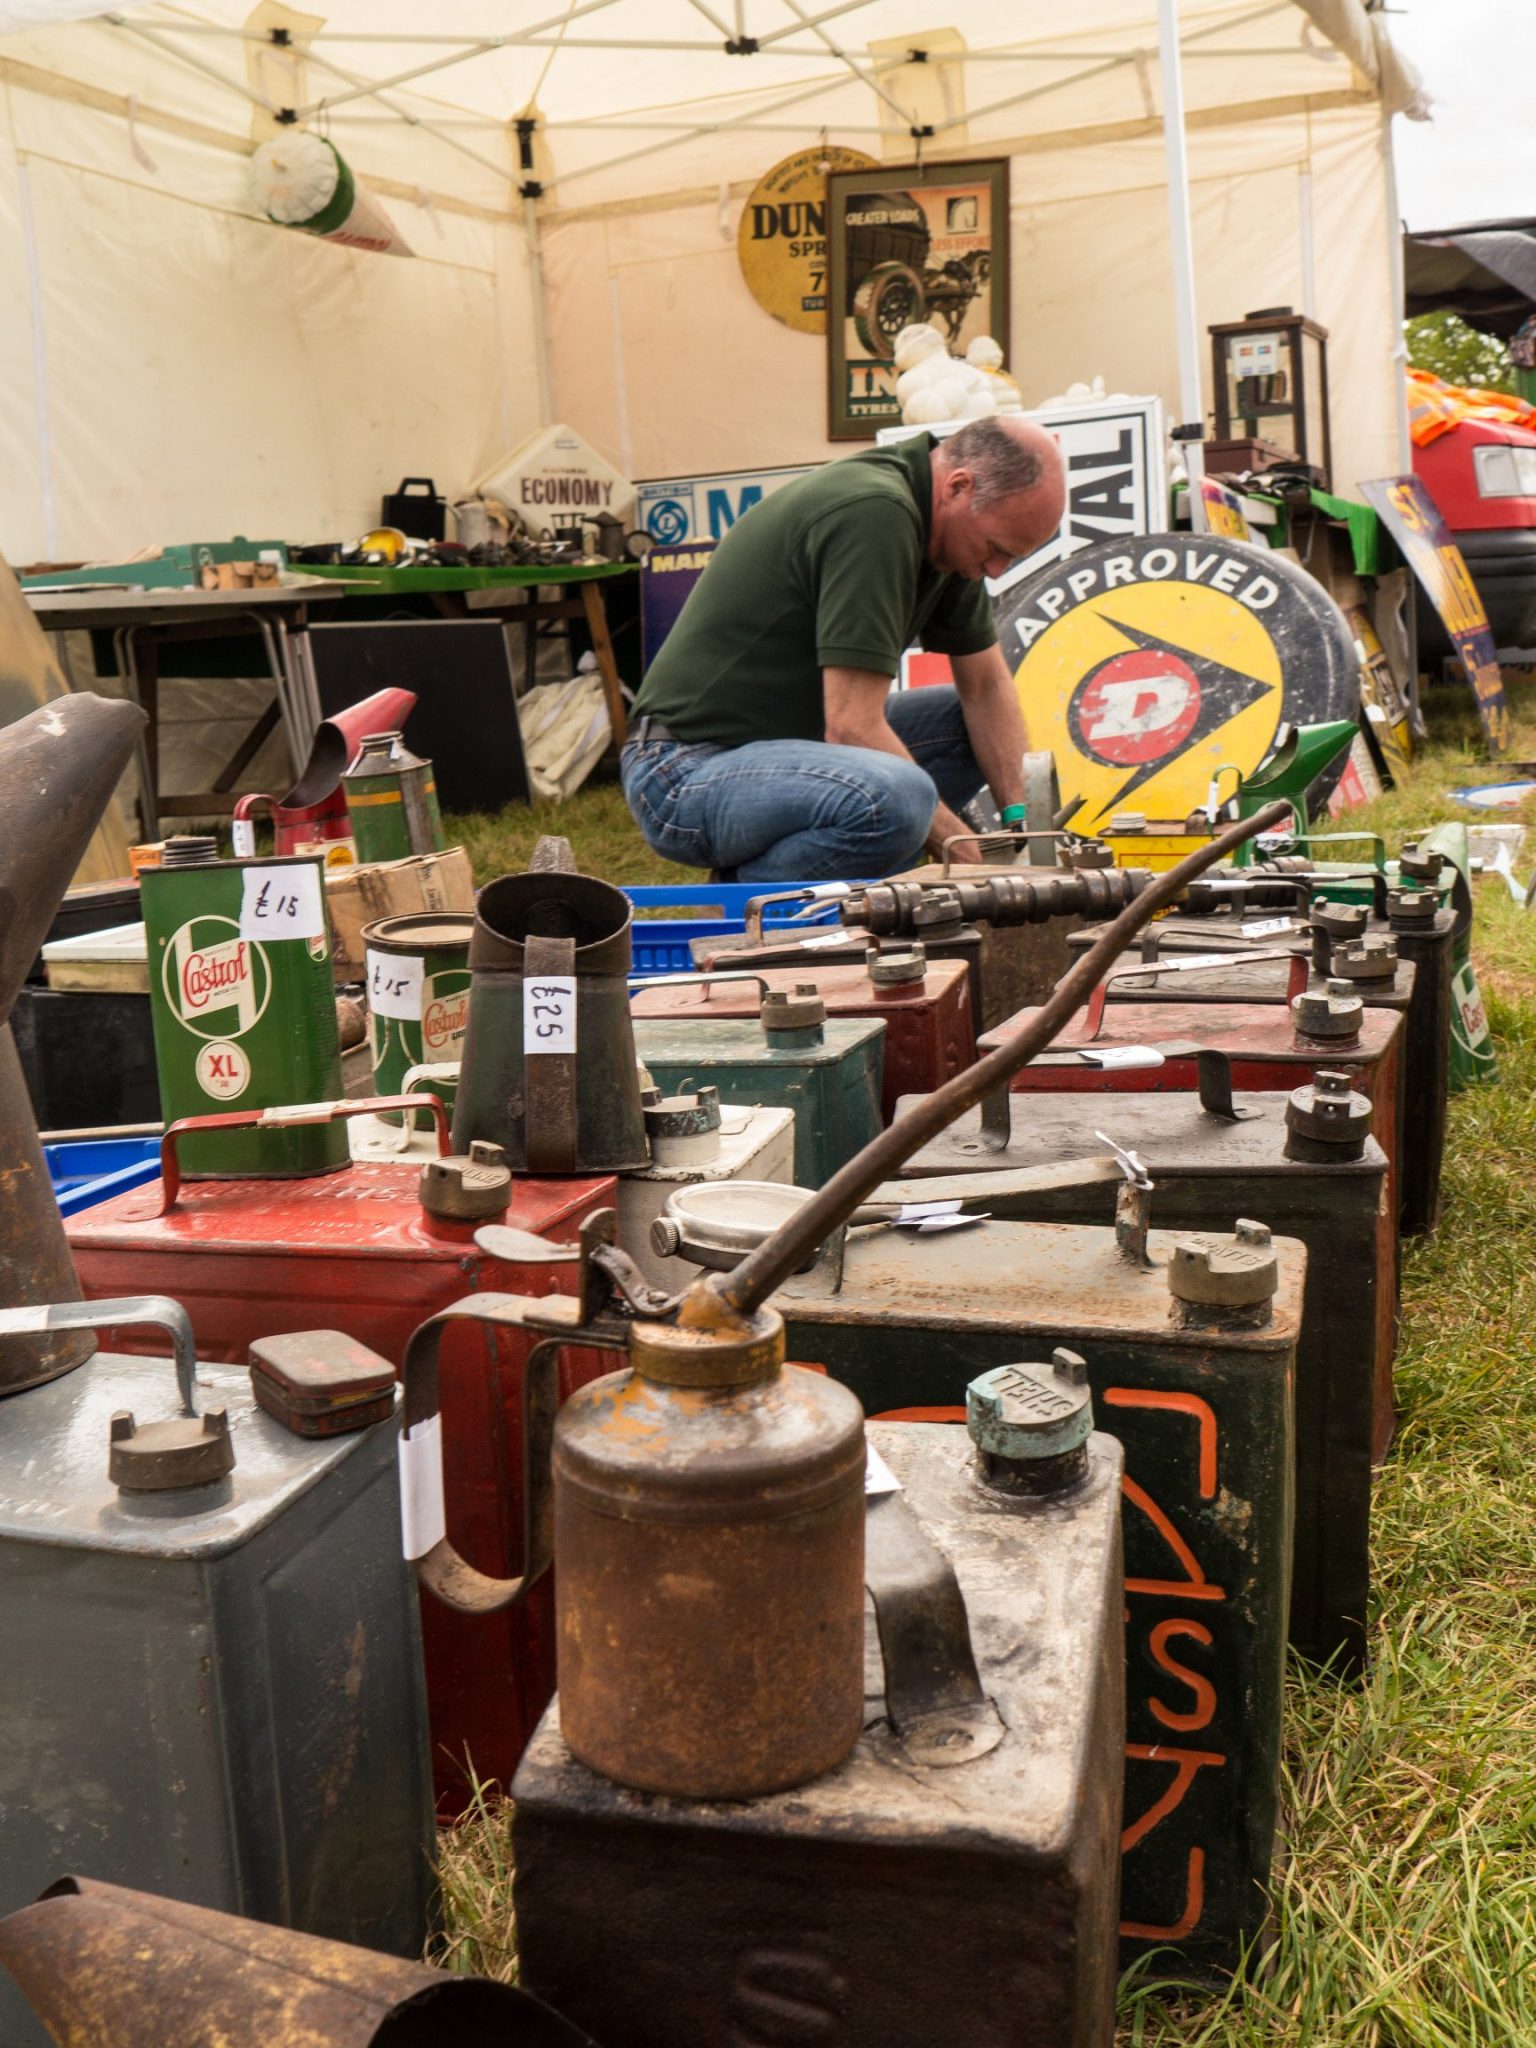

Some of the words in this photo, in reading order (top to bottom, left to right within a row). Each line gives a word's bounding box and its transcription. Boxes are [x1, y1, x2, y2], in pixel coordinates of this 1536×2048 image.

[849, 403, 900, 415] TYRES
[520, 477, 614, 506] ECONOMY
[1013, 548, 1280, 648] APPROVED
[1089, 675, 1192, 740] D
[255, 880, 298, 918] £15
[183, 940, 249, 1008] Castrol
[373, 965, 410, 998] £15
[530, 986, 572, 1038] £25
[208, 1055, 239, 1078] XL
[989, 1366, 1075, 1417] SHELL
